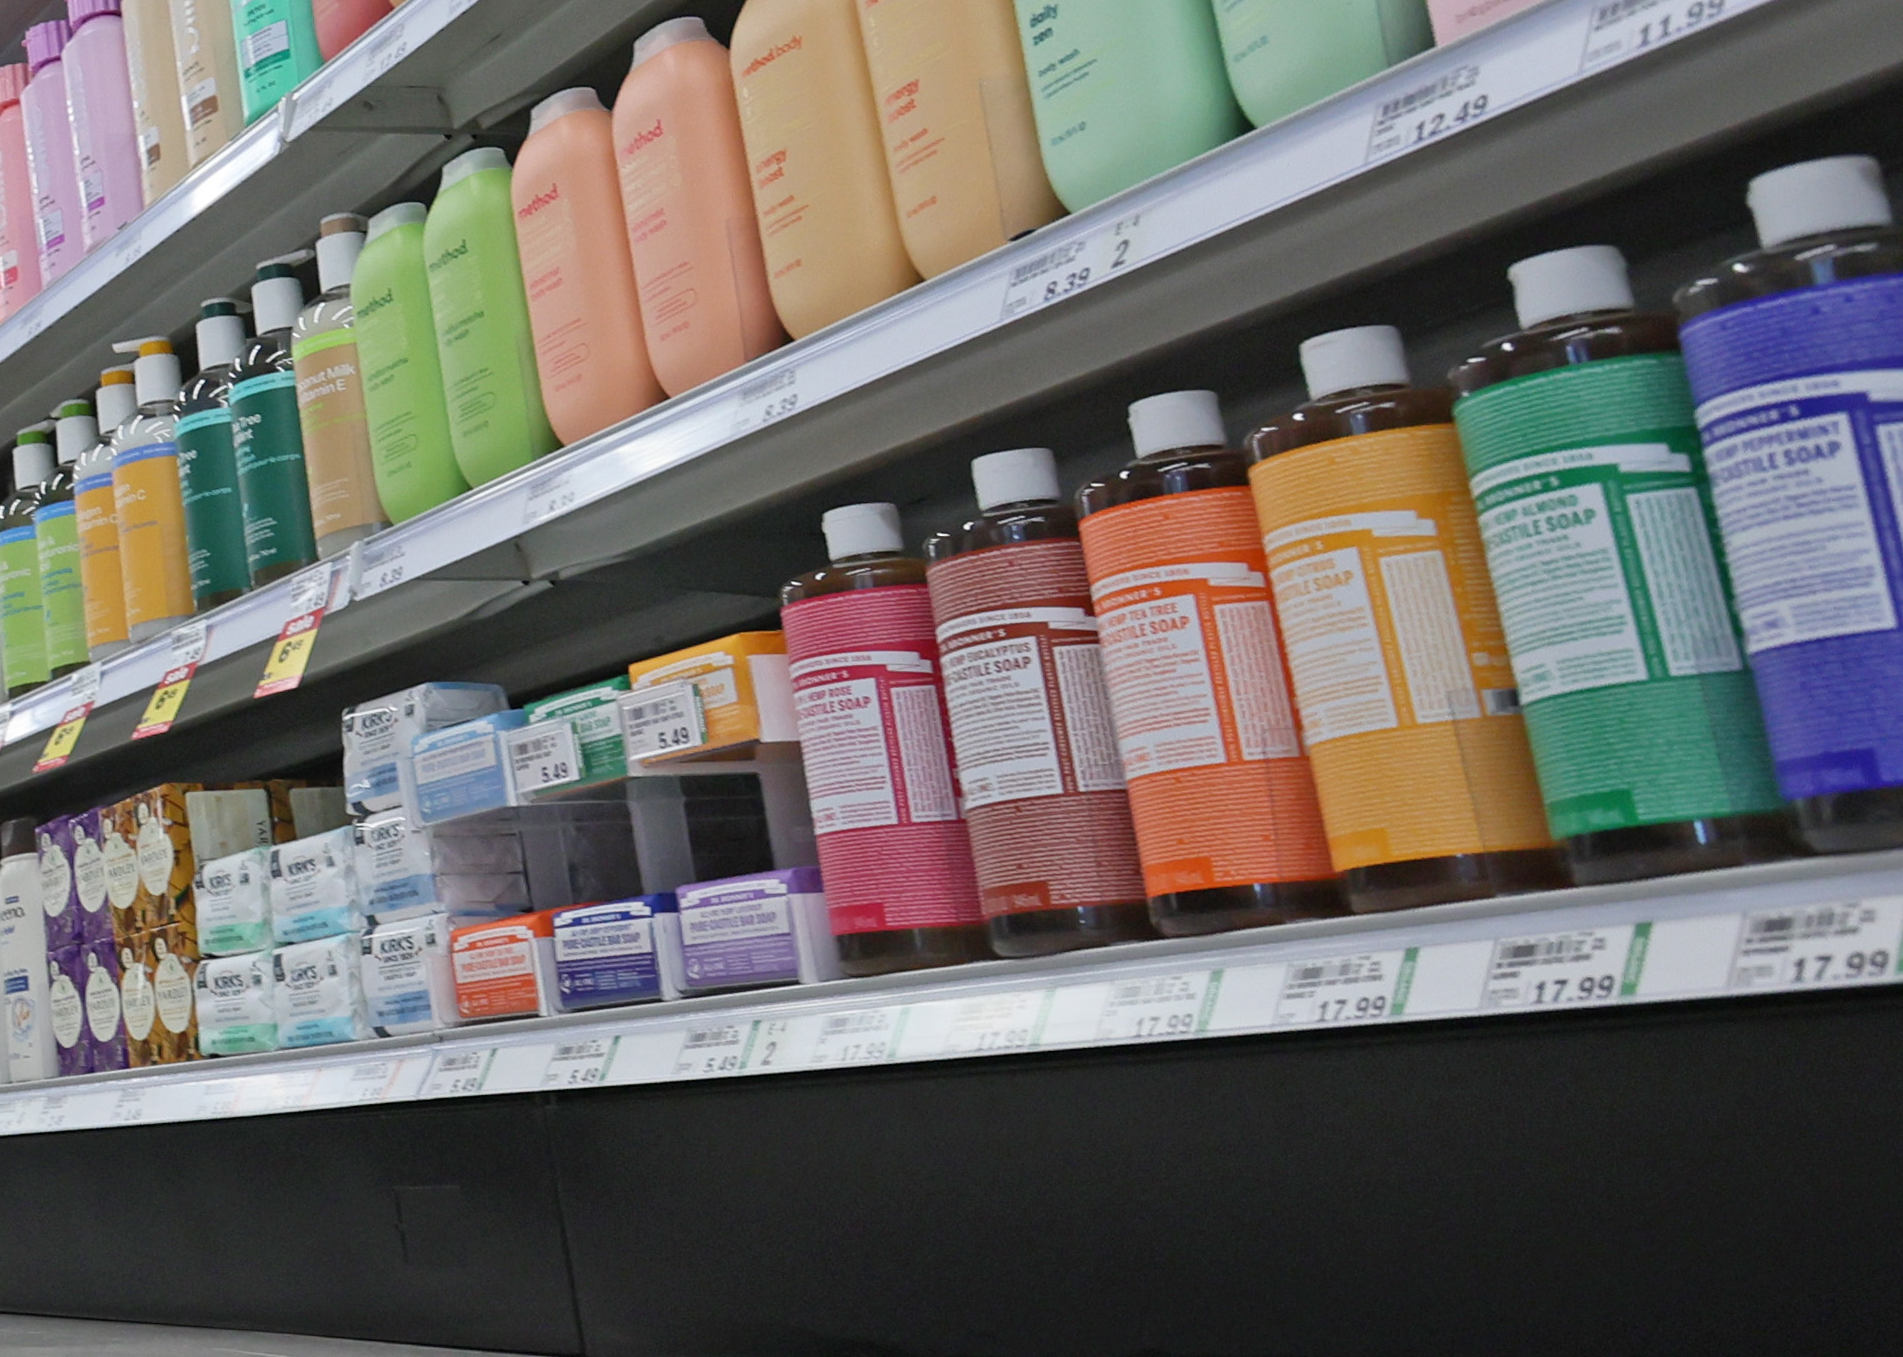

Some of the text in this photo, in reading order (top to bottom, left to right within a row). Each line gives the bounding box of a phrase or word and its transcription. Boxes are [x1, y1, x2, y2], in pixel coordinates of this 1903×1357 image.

[1029, 3, 1058, 28] daily
[1033, 27, 1054, 46] zen
[1411, 93, 1490, 145] 12.49
[1043, 238, 1130, 302] 8.39 2
[327, 364, 356, 380] Milk
[336, 380, 347, 391] E
[1783, 441, 1841, 466] SOAP
[1546, 508, 1597, 533] SOAP
[1315, 570, 1353, 591] SOAP
[1130, 602, 1178, 620] TEA TREE
[1150, 616, 1189, 634] SOAP
[968, 643, 1031, 662] EUCALYPTUS
[995, 657, 1031, 673] SOAP
[838, 696, 871, 711] SOAP
[658, 727, 690, 749] 5.49
[541, 763, 568, 783] 5.49
[287, 859, 316, 875] KIRK'S
[380, 936, 415, 954] KIRK'S
[1791, 950, 1890, 983] 17.99
[214, 975, 244, 990] KIRK'S
[1533, 975, 1615, 1005] 17.99
[1317, 995, 1386, 1023] 17.99
[1133, 1013, 1194, 1036] 17.99
[759, 1041, 774, 1066] 2
